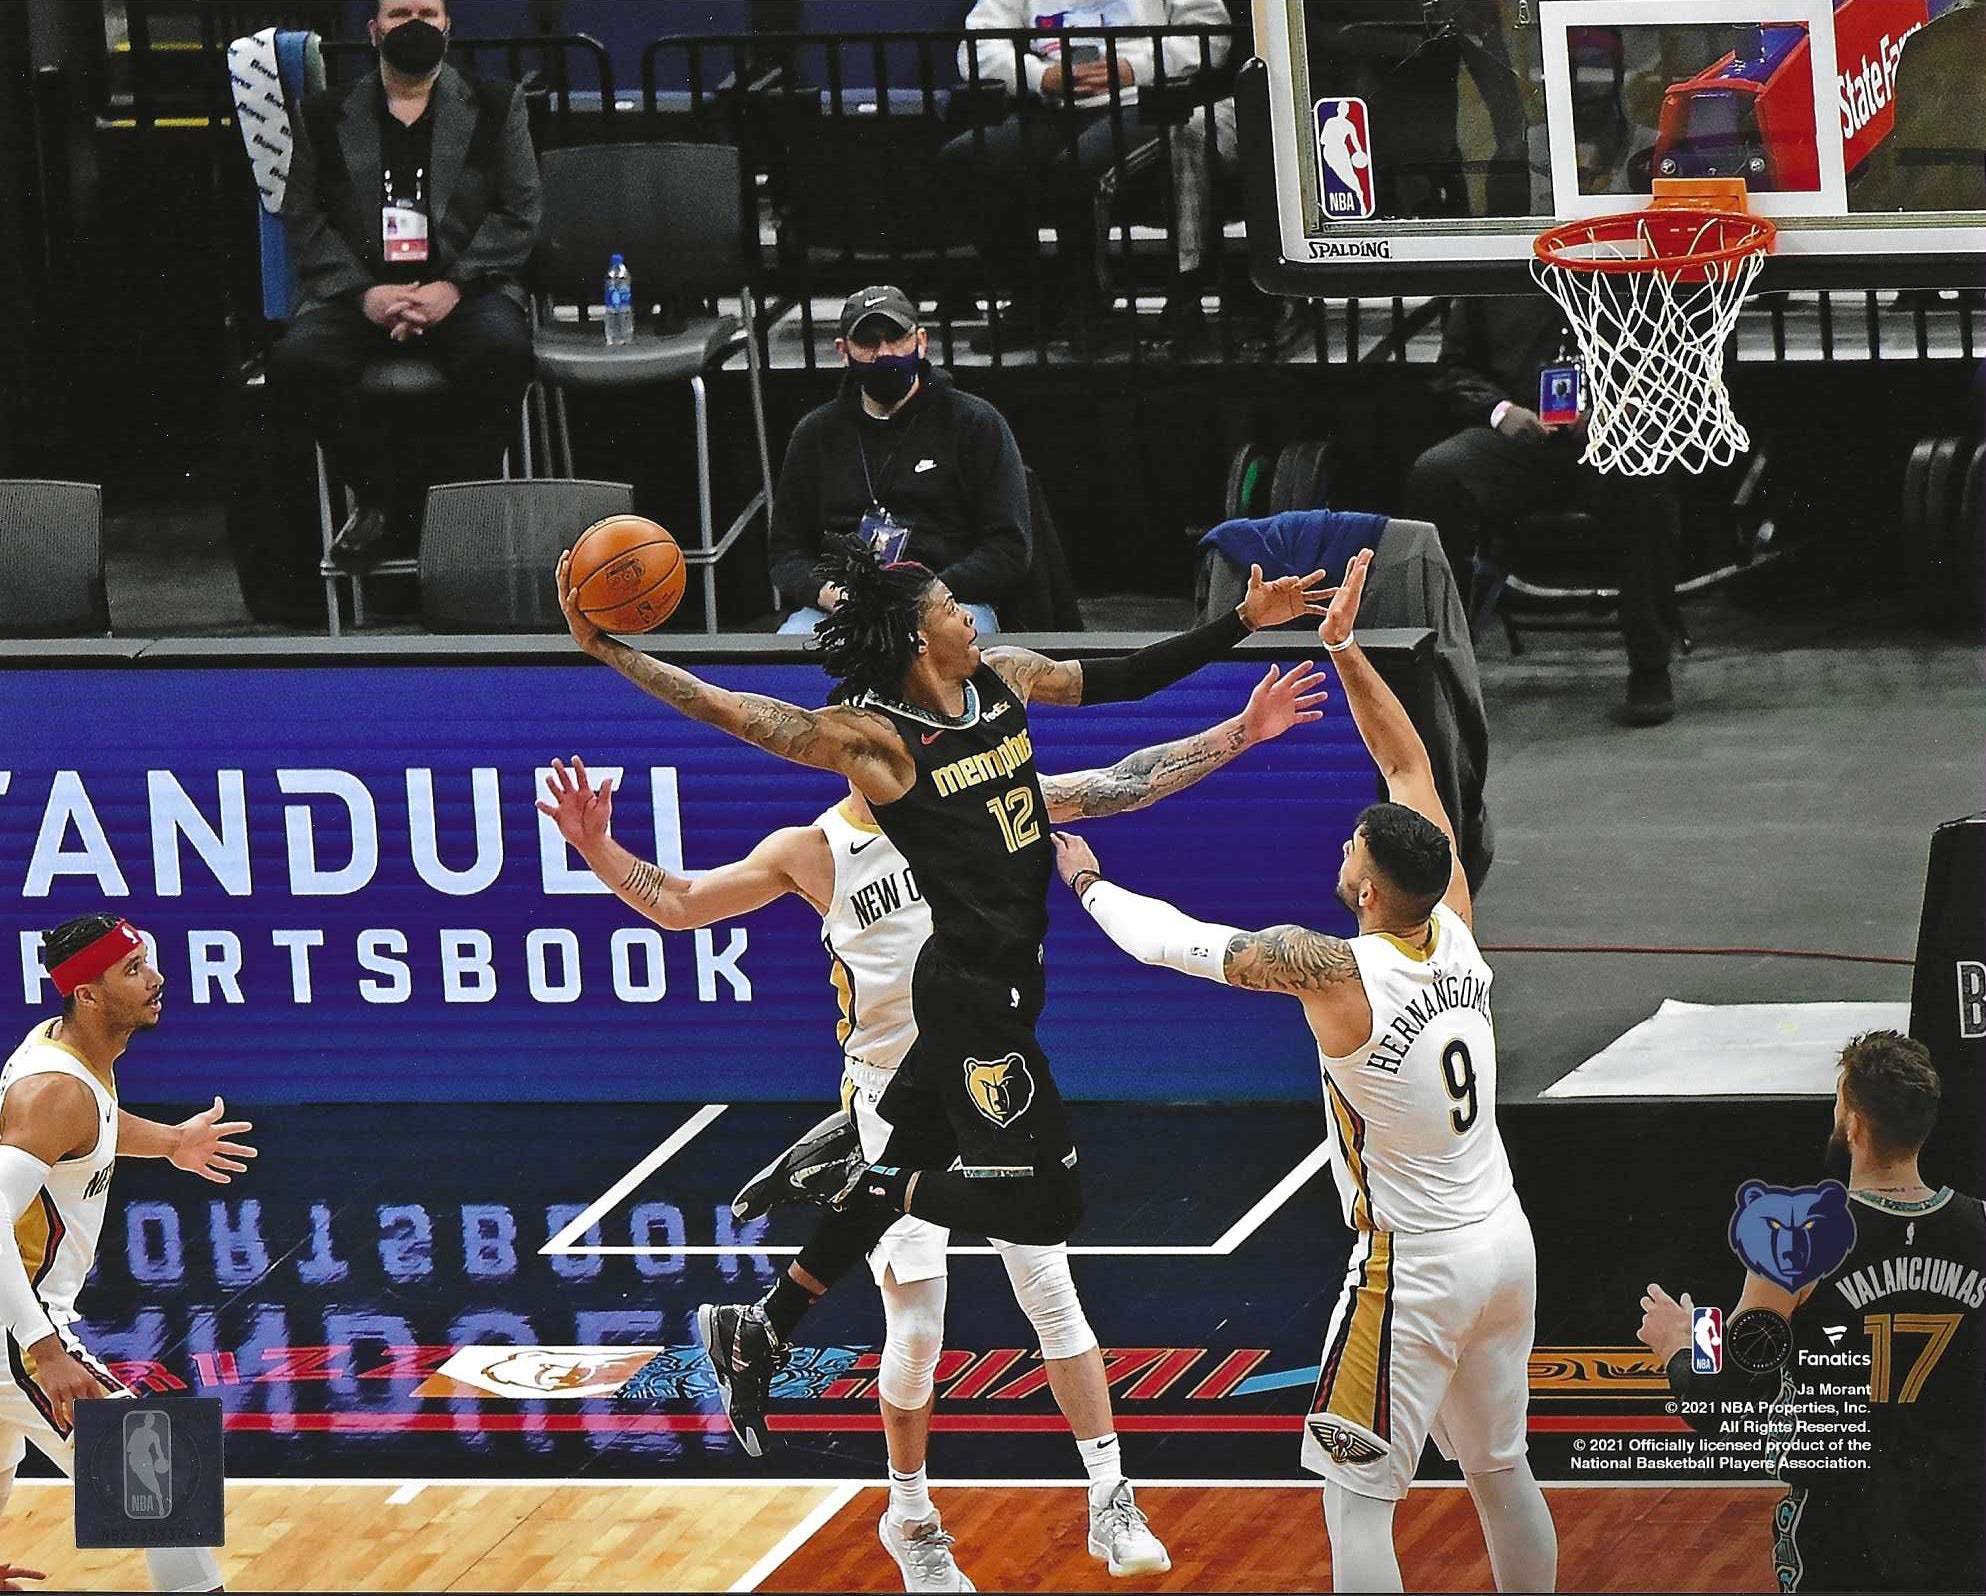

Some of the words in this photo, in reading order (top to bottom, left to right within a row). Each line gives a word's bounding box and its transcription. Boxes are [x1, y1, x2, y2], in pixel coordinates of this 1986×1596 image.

[1329, 192, 1355, 212] NBA
[986, 786, 1041, 854] 12
[850, 873, 901, 930] NEW
[1440, 1037, 1478, 1136] 9
[1835, 1256, 1986, 1310] VALANCIUNAS
[1864, 1313, 1965, 1403] 17
